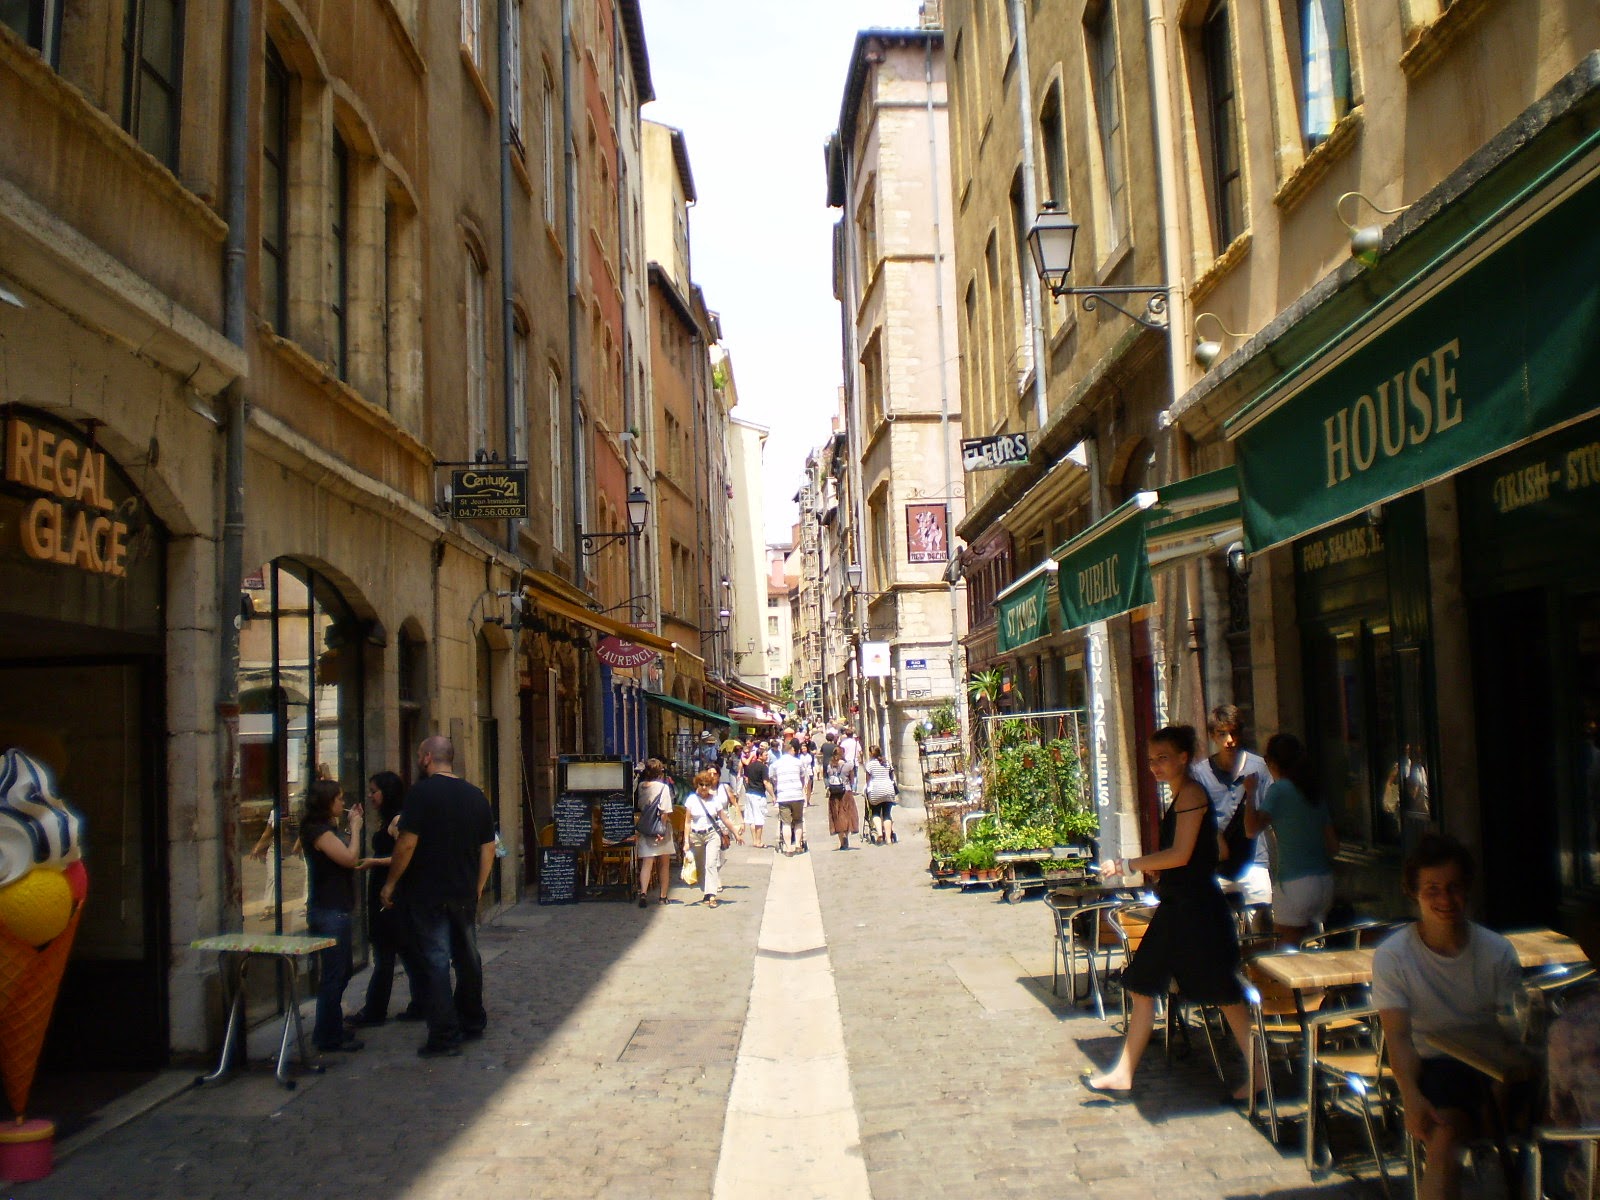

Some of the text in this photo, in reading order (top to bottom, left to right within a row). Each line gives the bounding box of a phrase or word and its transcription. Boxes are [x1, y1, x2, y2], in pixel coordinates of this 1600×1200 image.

[1324, 337, 1463, 488] HOUSE
[7, 419, 113, 511] REGAL
[963, 434, 1027, 466] FLEURS
[462, 472, 518, 496] Century 21
[459, 507, 521, 517] 04.72.56.06.02
[20, 498, 128, 578] GLACE
[1078, 554, 1120, 609] PUBLIC
[1007, 595, 1038, 640] ST JAMES
[1091, 635, 1103, 682] AUX
